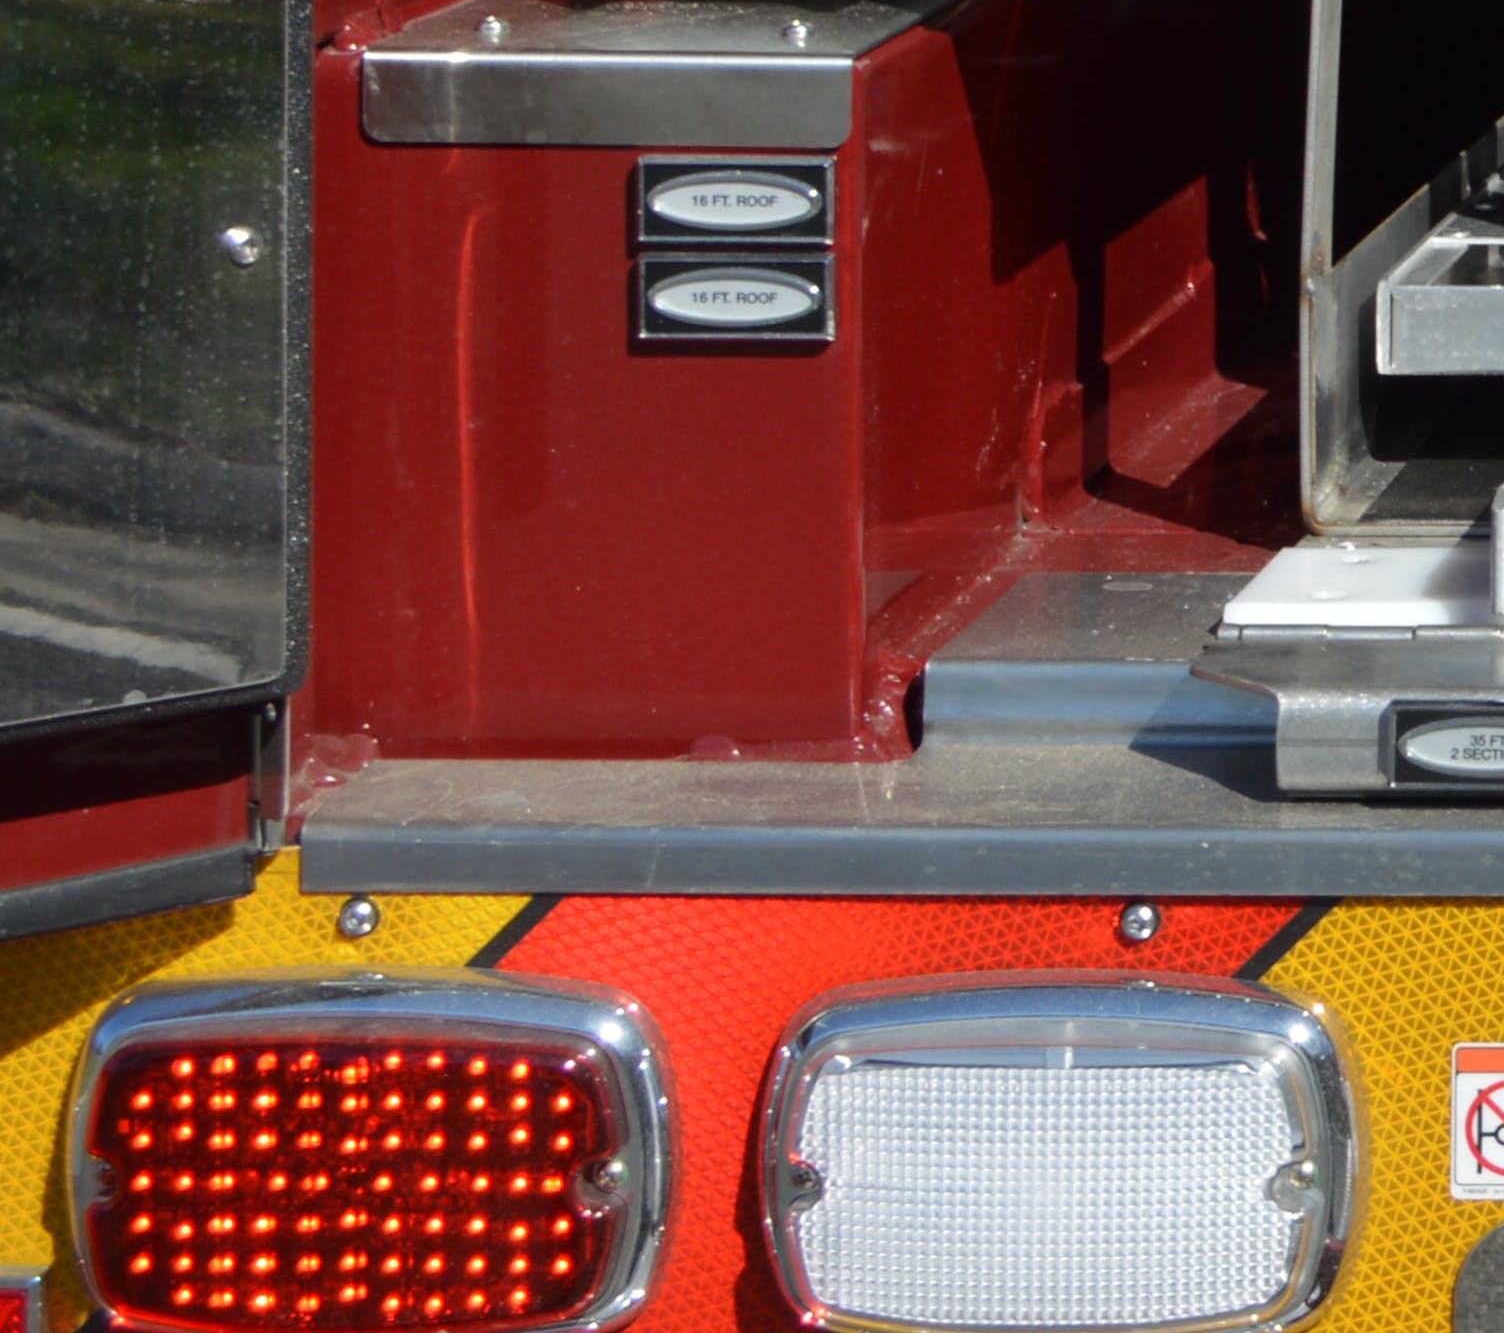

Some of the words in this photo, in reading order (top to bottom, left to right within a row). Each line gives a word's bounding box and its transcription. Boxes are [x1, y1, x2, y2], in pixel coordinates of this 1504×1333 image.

[691, 195, 708, 207] 16
[736, 195, 779, 207] ROOF
[691, 292, 708, 304] 16
[736, 292, 779, 304] ROOF
[1470, 734, 1487, 747] 35
[1450, 748, 1460, 761] 2
